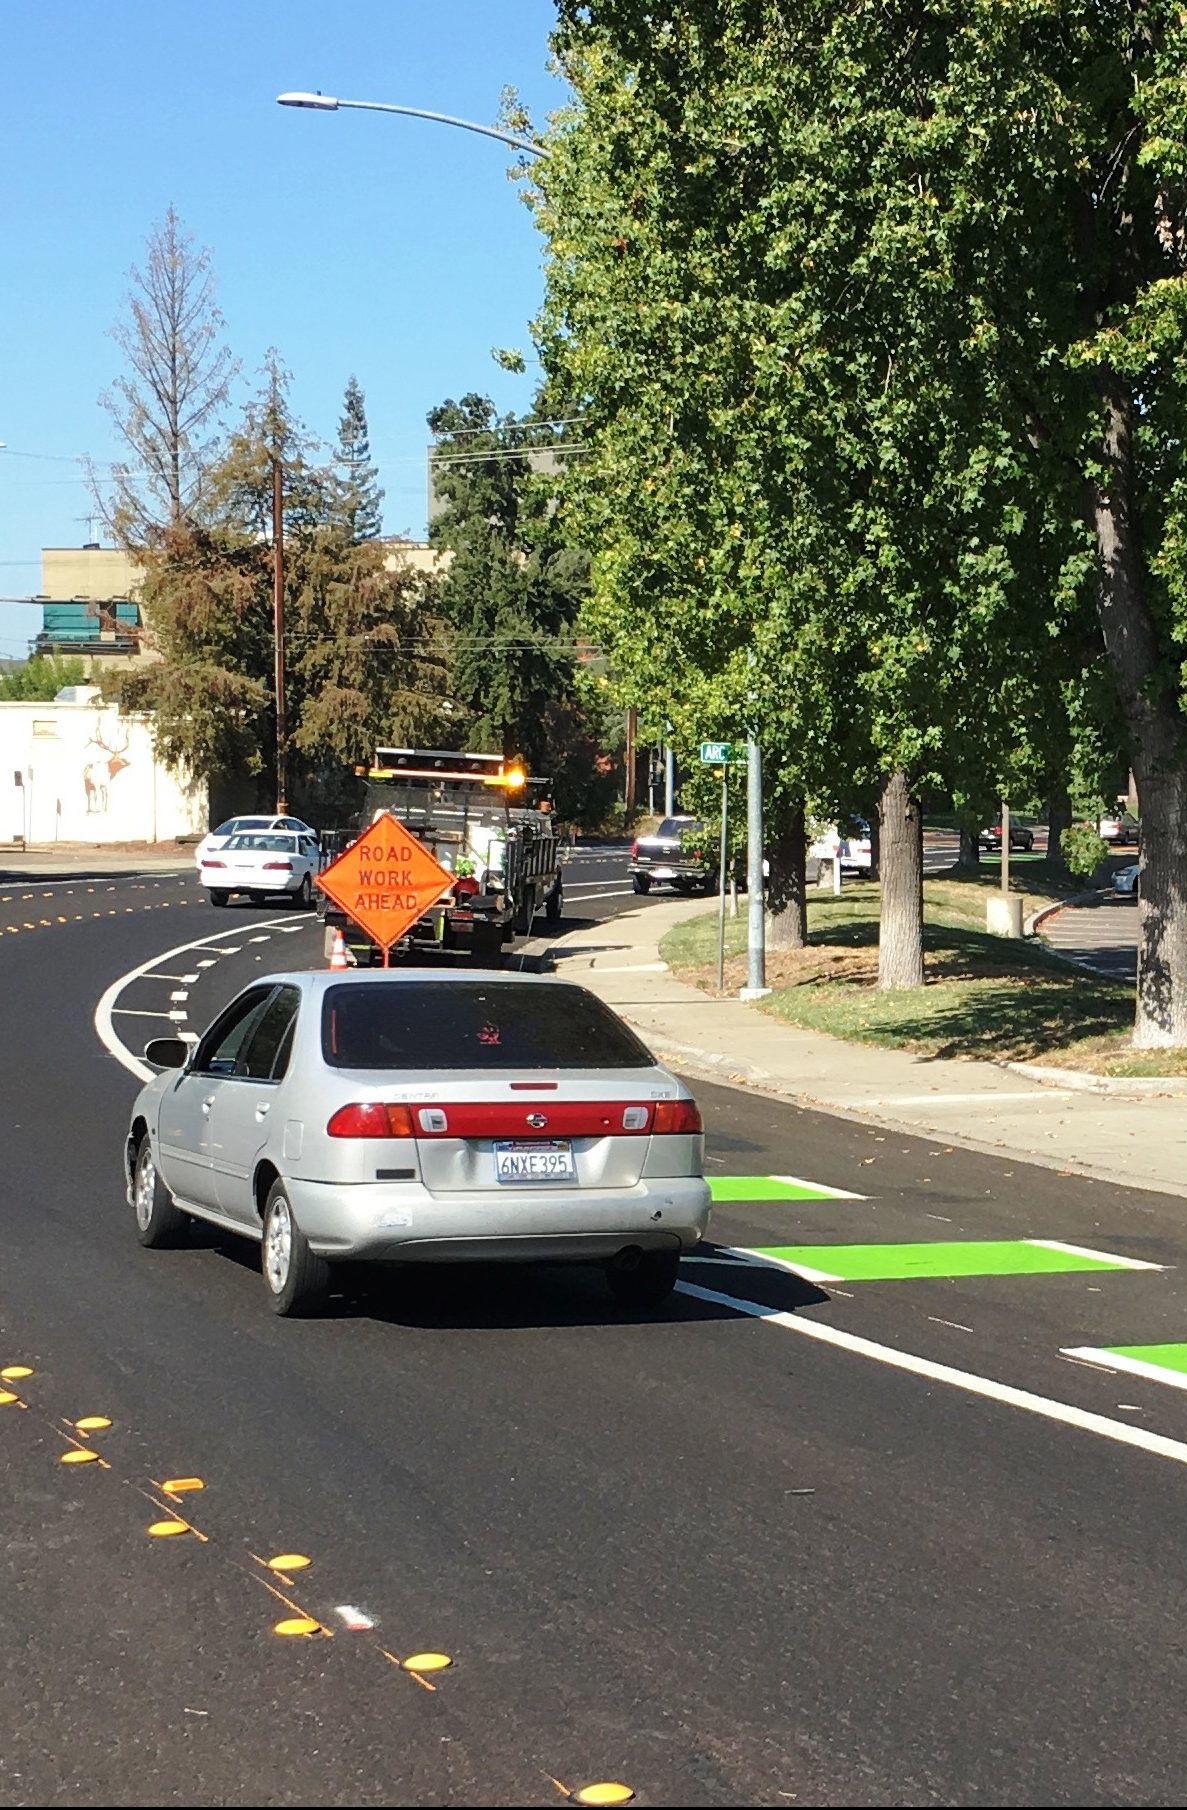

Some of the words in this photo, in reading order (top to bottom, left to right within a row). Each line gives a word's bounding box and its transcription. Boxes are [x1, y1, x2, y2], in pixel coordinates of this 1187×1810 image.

[359, 845, 413, 862] ROAD
[358, 870, 413, 886] WORK
[354, 893, 417, 911] AHEAD
[500, 1154, 567, 1174] 6NXE395
